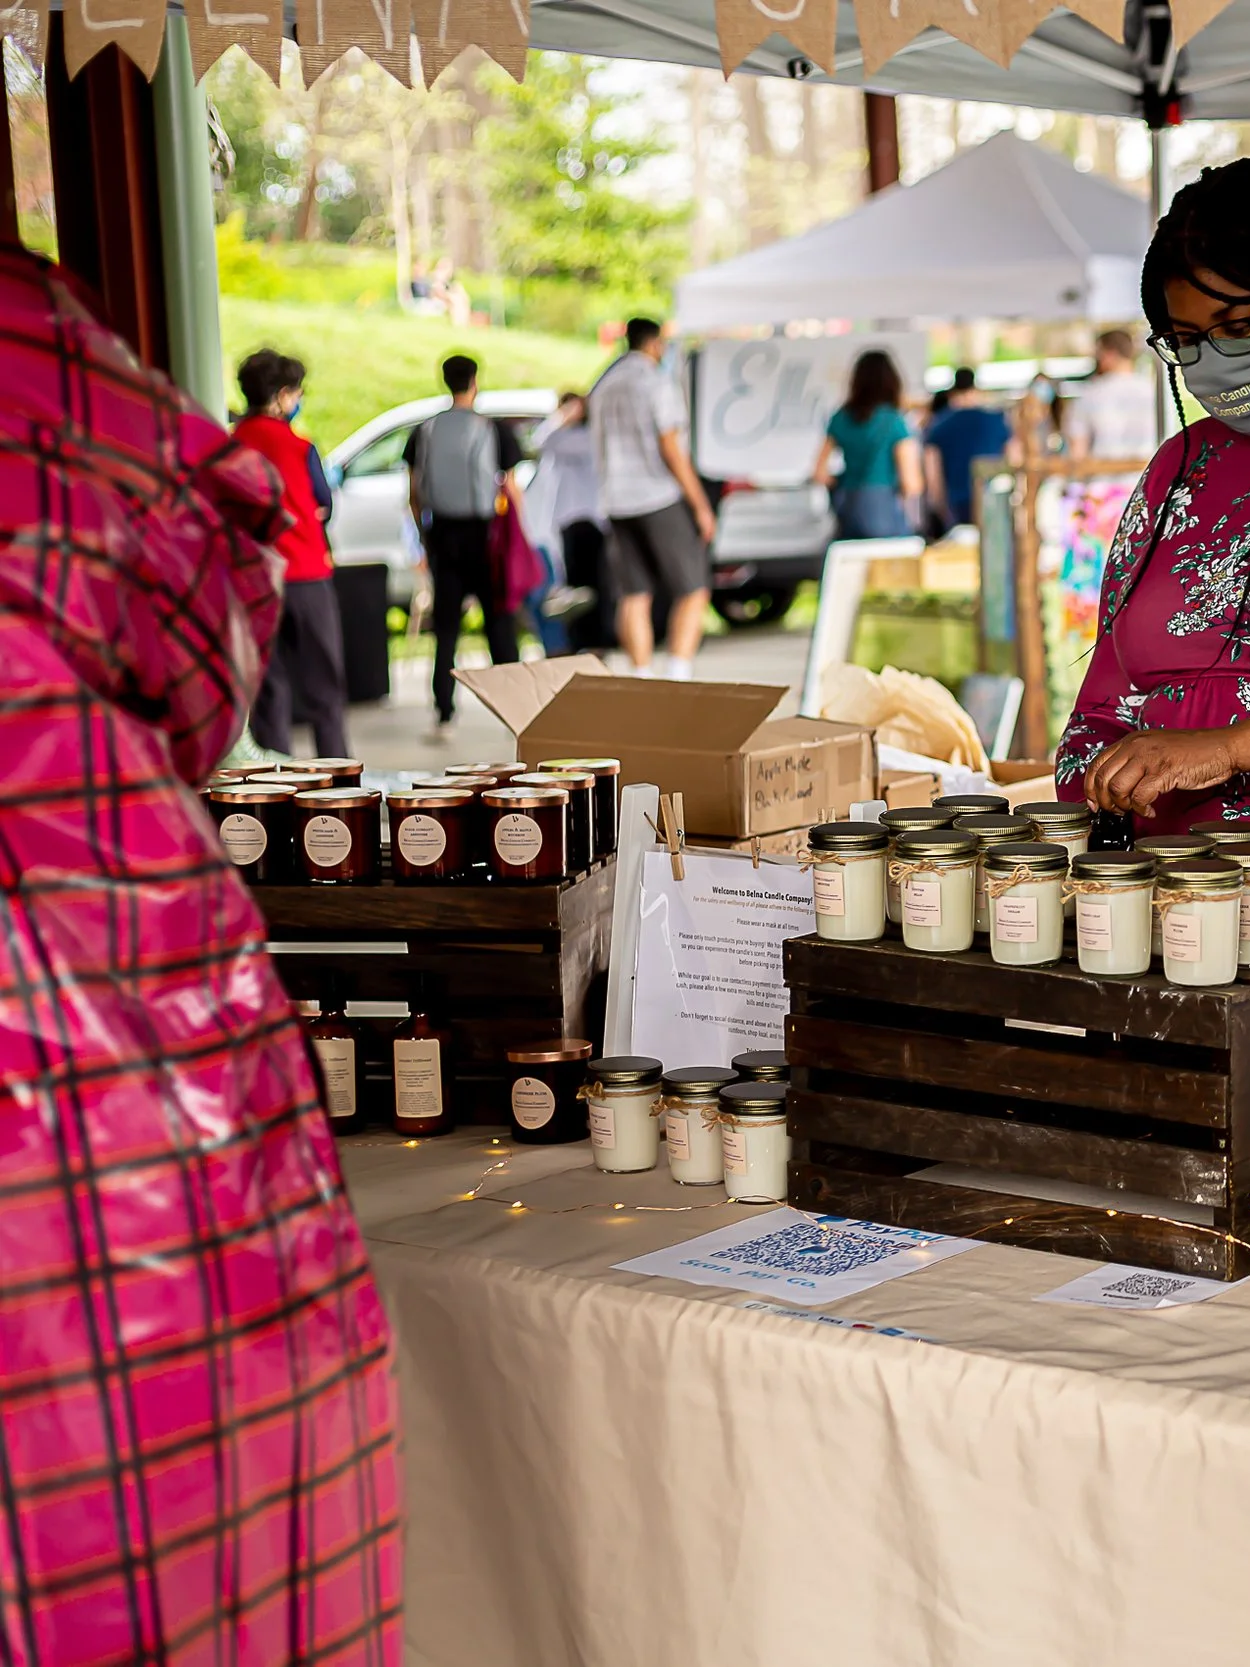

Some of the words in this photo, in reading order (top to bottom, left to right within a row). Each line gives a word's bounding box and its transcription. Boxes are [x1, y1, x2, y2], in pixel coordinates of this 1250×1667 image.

[712, 886, 738, 895] Welcome
[746, 890, 763, 898] Belna
[764, 891, 784, 900] Candle
[785, 893, 813, 905] Company!
[753, 961, 768, 969] picking
[849, 1220, 945, 1242] PayPal
[679, 1259, 732, 1274] Scan.
[786, 1277, 817, 1289] Go.
